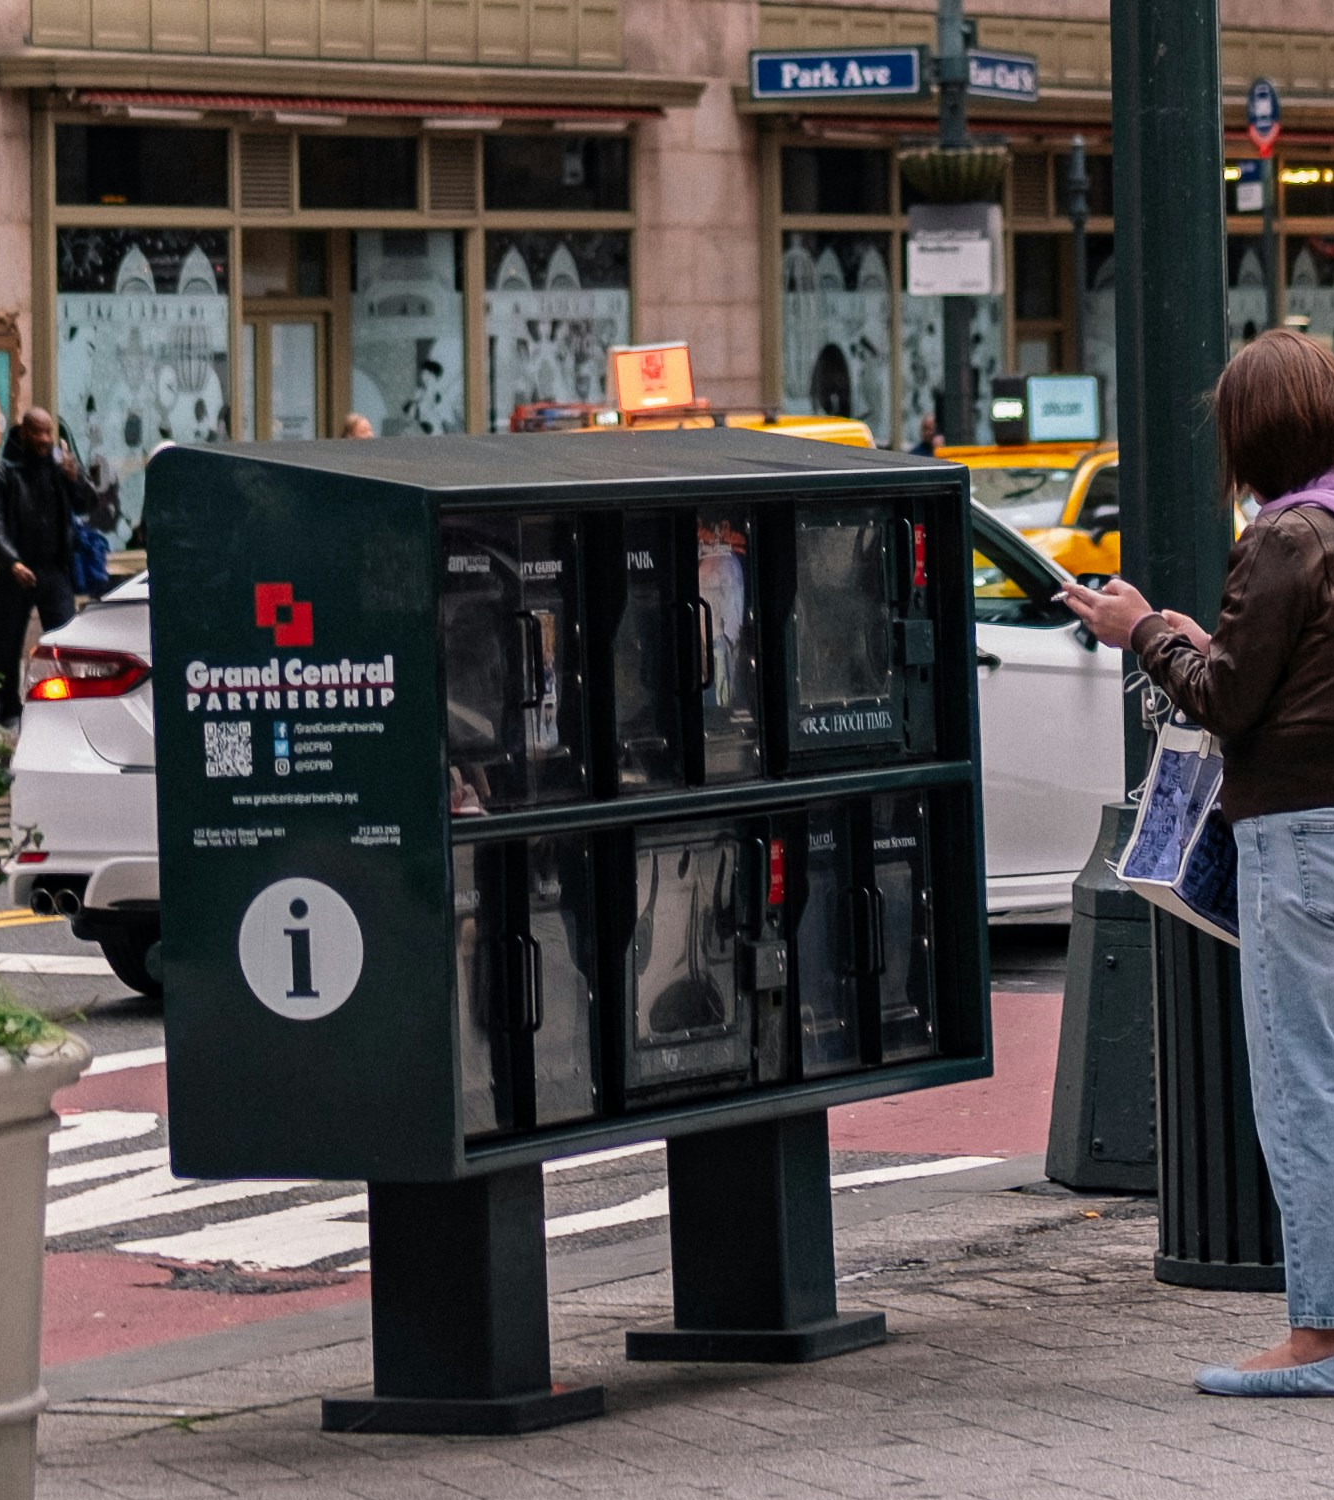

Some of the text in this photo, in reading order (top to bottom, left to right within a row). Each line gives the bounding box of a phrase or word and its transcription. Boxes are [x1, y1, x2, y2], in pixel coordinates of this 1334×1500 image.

[781, 60, 891, 89] Park Ave
[627, 551, 655, 570] PARK
[186, 654, 394, 689] Grand Central
[187, 688, 394, 711] PARTNERSHIP
[834, 711, 864, 732] EPOCH
[866, 711, 893, 730] TIMES
